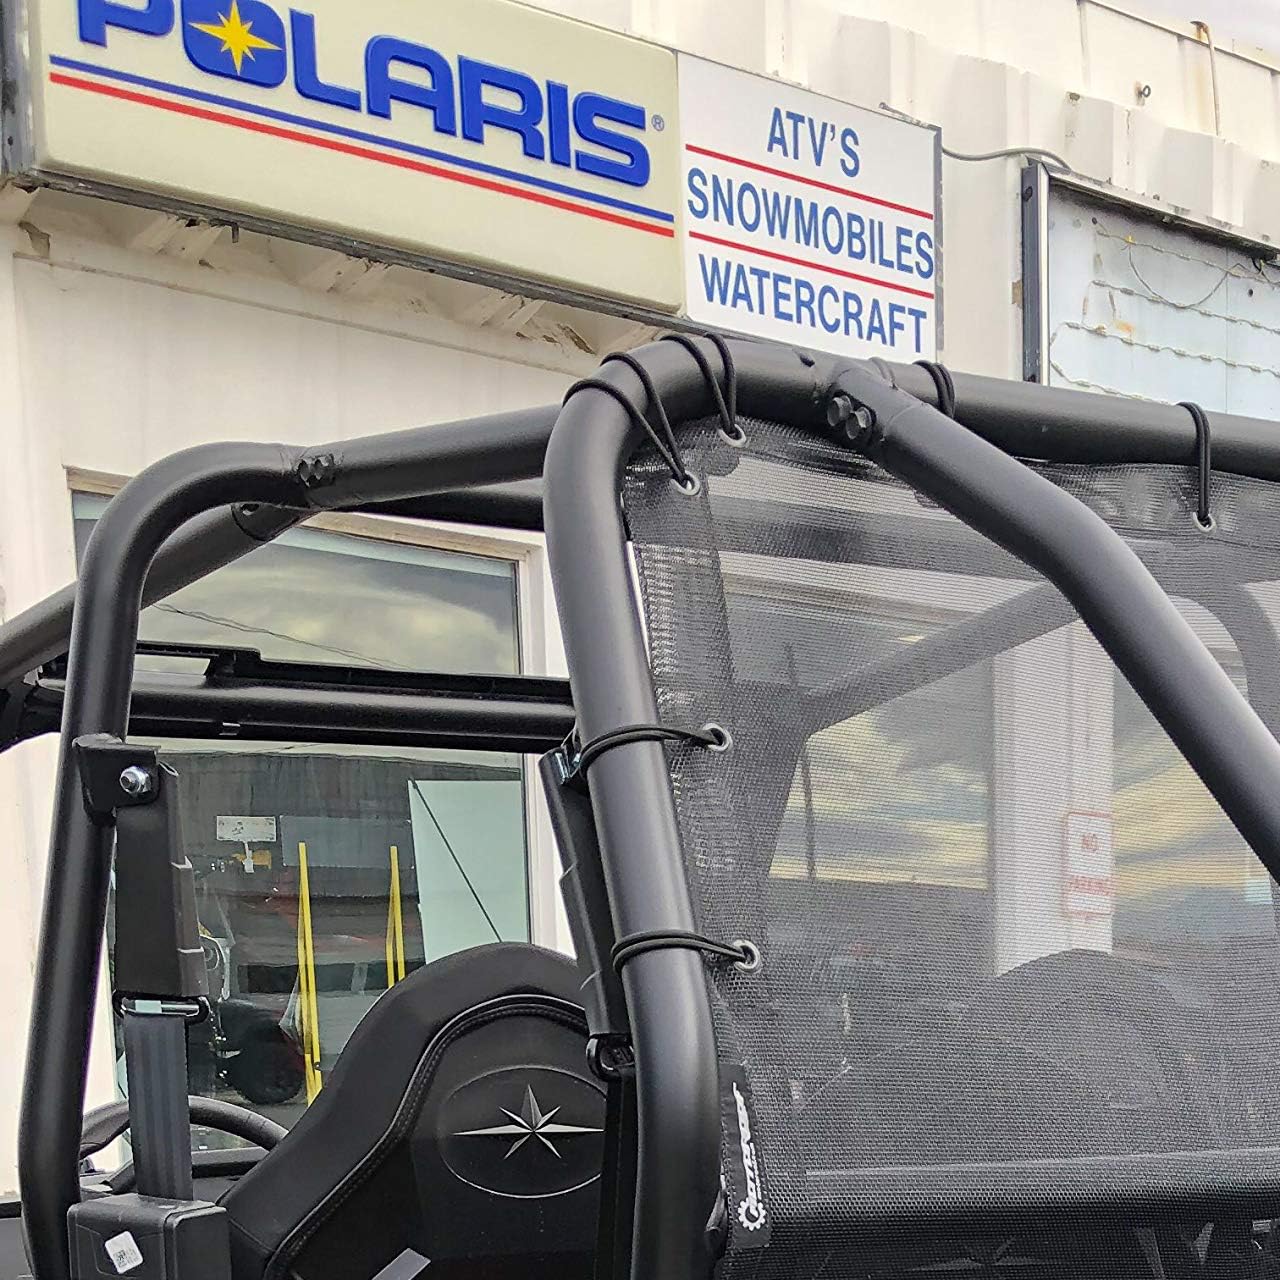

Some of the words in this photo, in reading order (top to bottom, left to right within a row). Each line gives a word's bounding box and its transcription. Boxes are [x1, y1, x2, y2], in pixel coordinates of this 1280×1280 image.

[767, 106, 861, 178] ATV'S
[687, 167, 935, 280] SNOWMOBILES
[698, 253, 928, 354] WATERCRAFT
